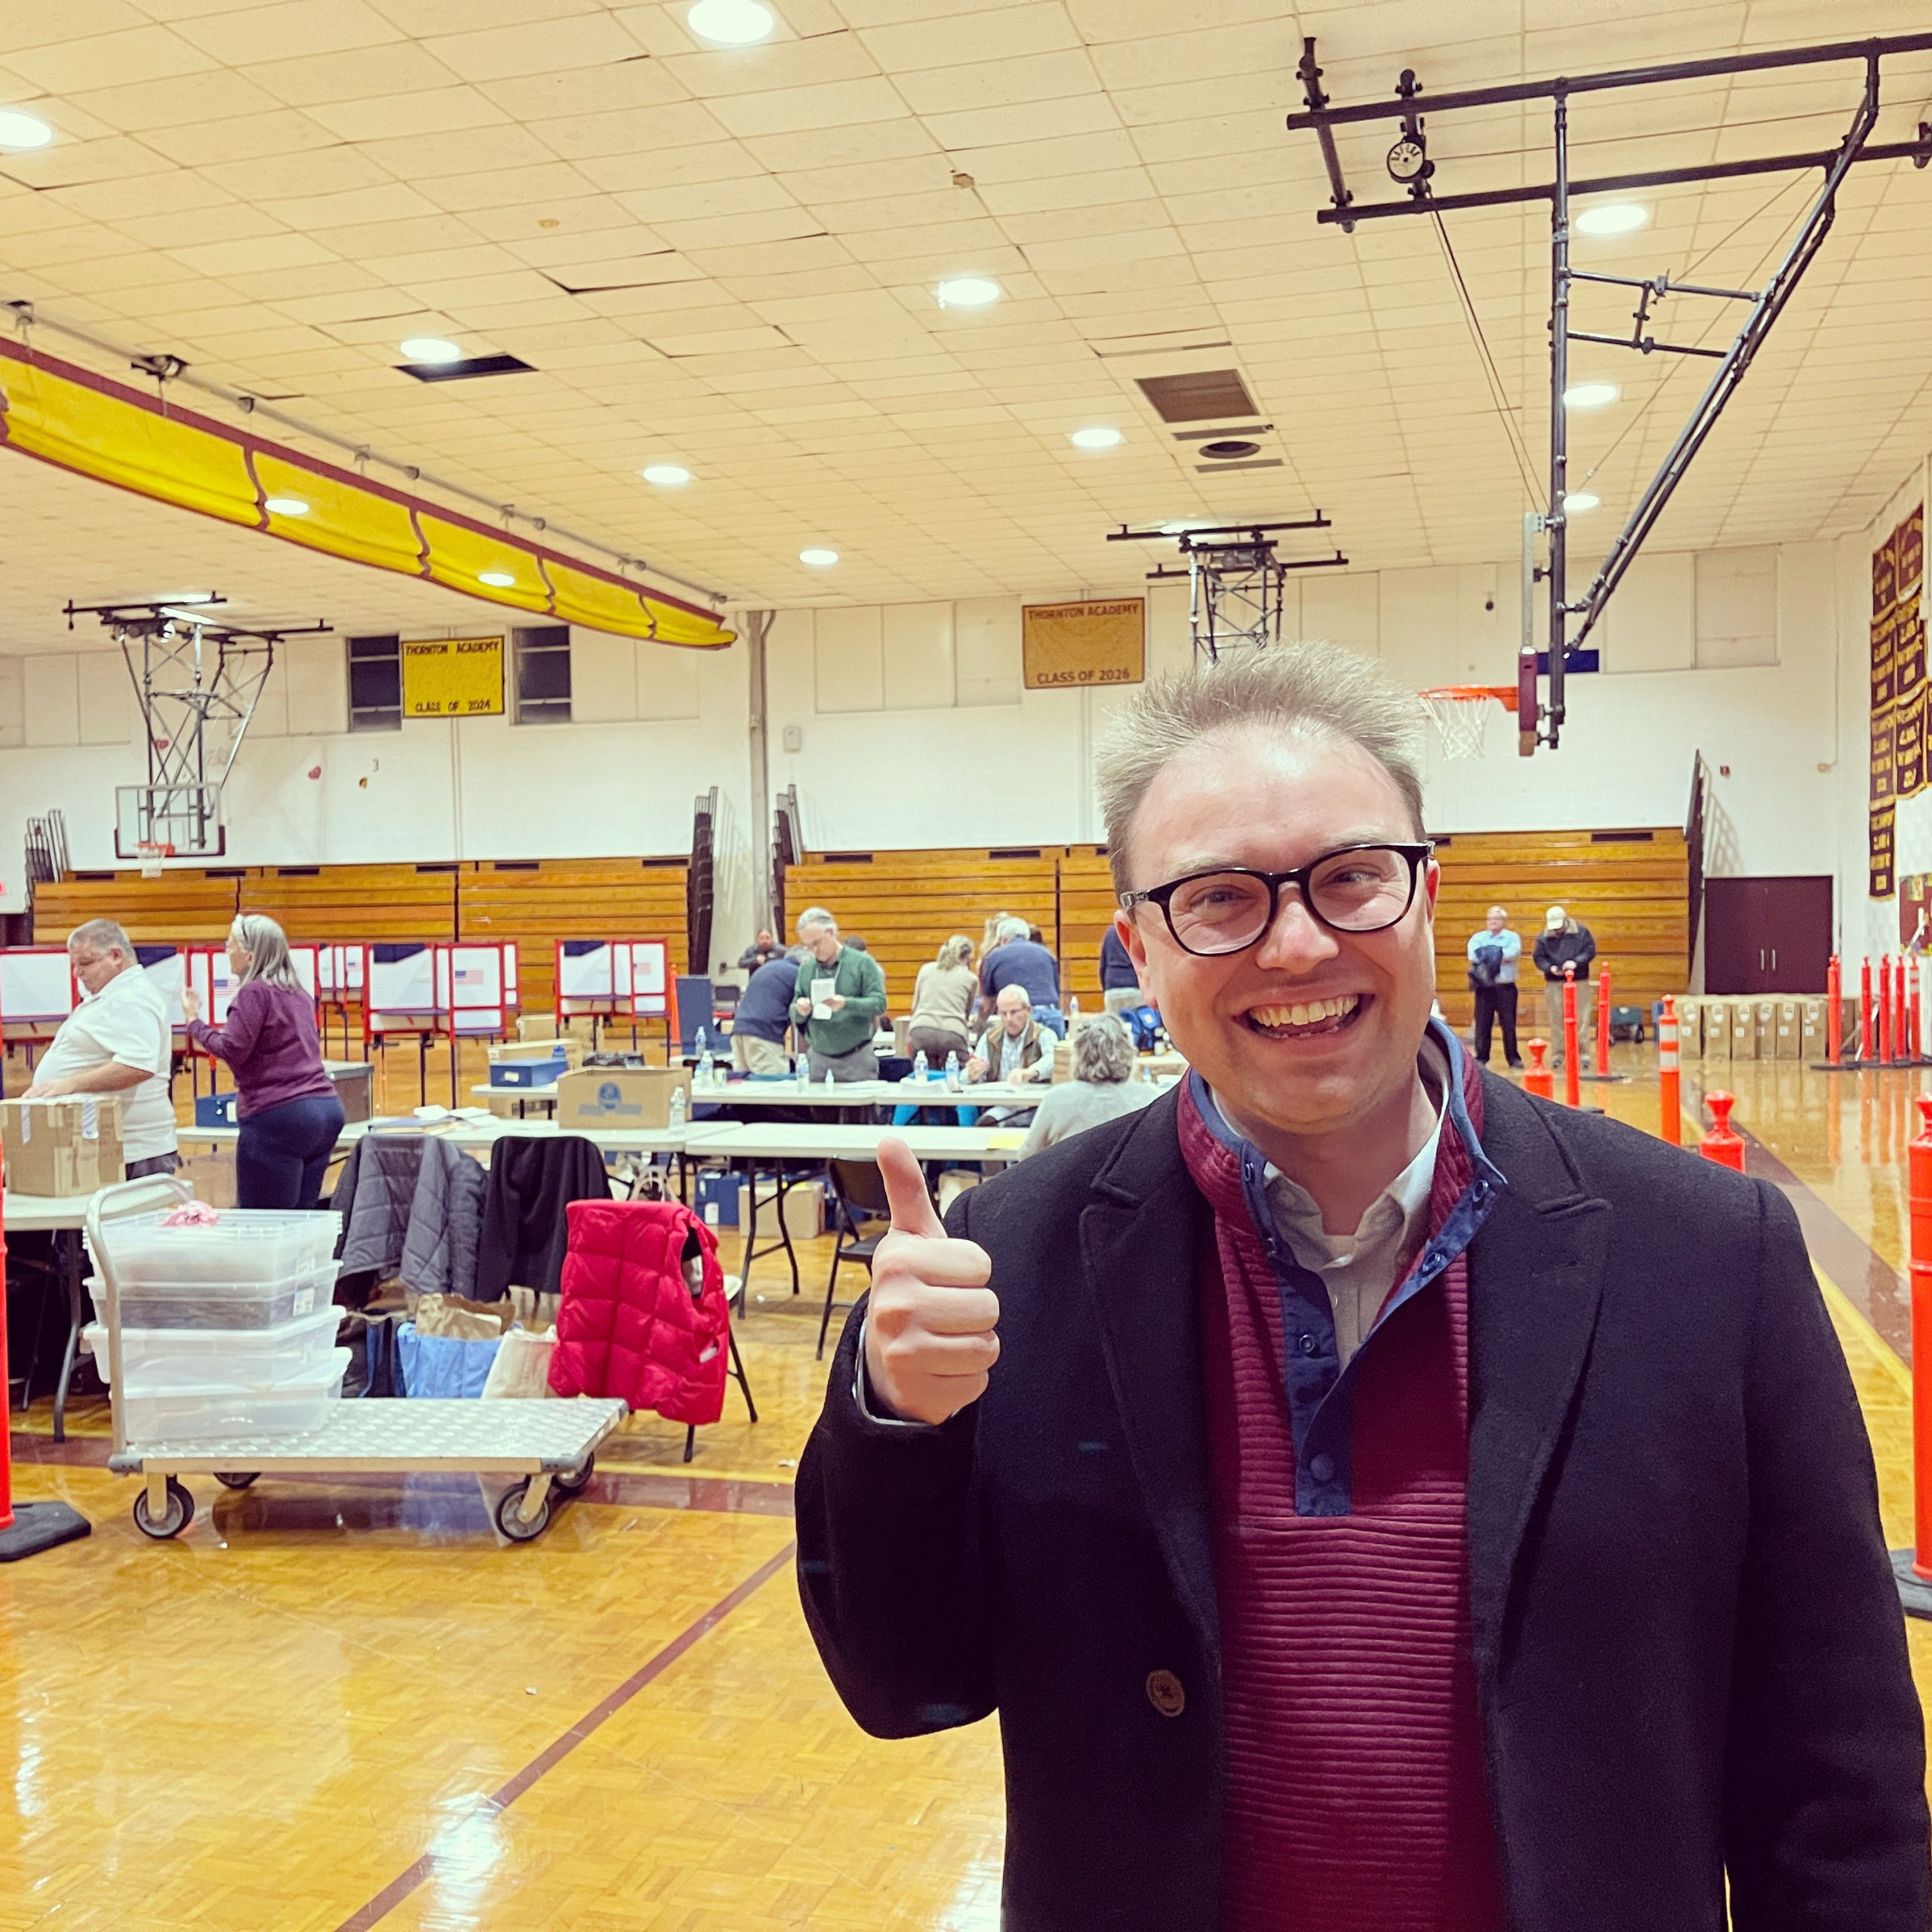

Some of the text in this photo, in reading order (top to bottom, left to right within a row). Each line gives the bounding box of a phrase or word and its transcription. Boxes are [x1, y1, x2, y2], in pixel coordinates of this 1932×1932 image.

[1028, 603, 1140, 621] THORNTON ACADEMY
[406, 641, 499, 656] THORNTON ACADEMY
[1037, 669, 1131, 684] CLASS OF 2026
[415, 701, 441, 712] CLASS
[448, 700, 460, 712] OF
